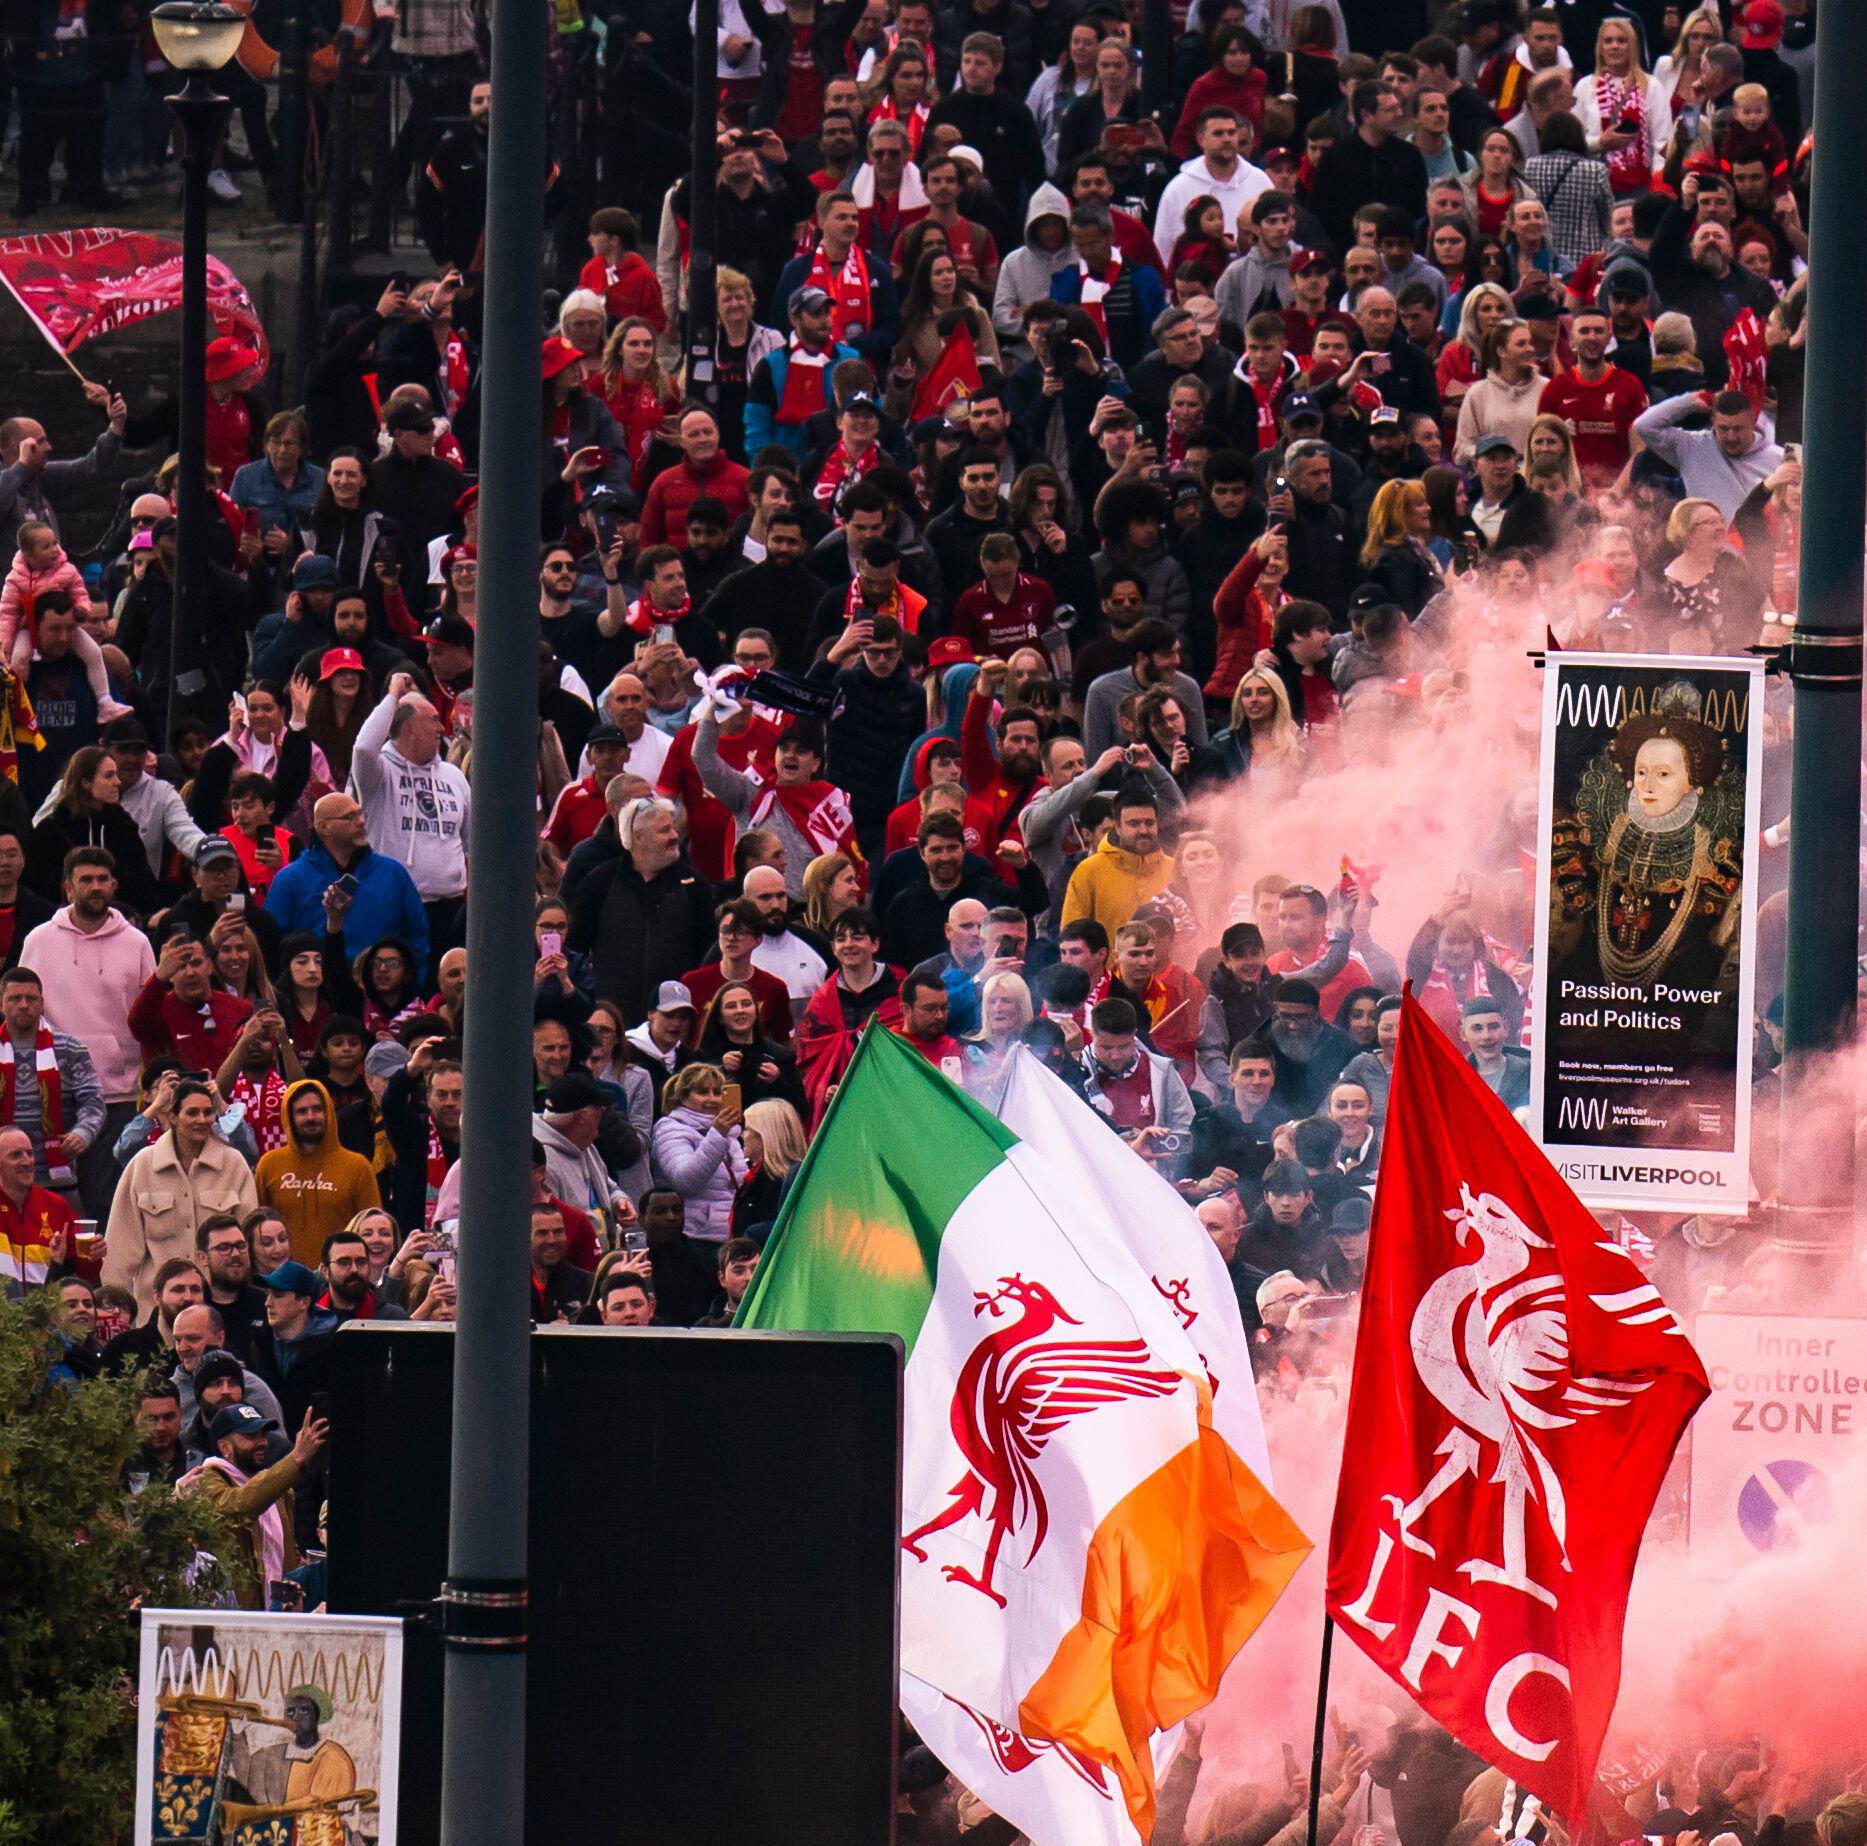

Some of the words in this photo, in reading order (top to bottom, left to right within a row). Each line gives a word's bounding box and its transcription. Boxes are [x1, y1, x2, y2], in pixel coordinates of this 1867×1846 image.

[1560, 981, 1648, 1003] Passion,
[1654, 984, 1722, 1005] Power
[1560, 1009, 1598, 1027] and
[1604, 1011, 1682, 1031] Politics
[1559, 1061, 1580, 1070] Book
[1603, 1062, 1642, 1073] members
[1644, 1064, 1656, 1074] go
[1657, 1064, 1674, 1073] free
[1612, 1105, 1648, 1116] Walker
[1612, 1116, 1629, 1126] Art
[1630, 1117, 1668, 1129] Gallery
[1757, 1330, 1836, 1358] Inner
[1732, 1401, 1853, 1435] ZONE
[1341, 1530, 1573, 1763] LFC
